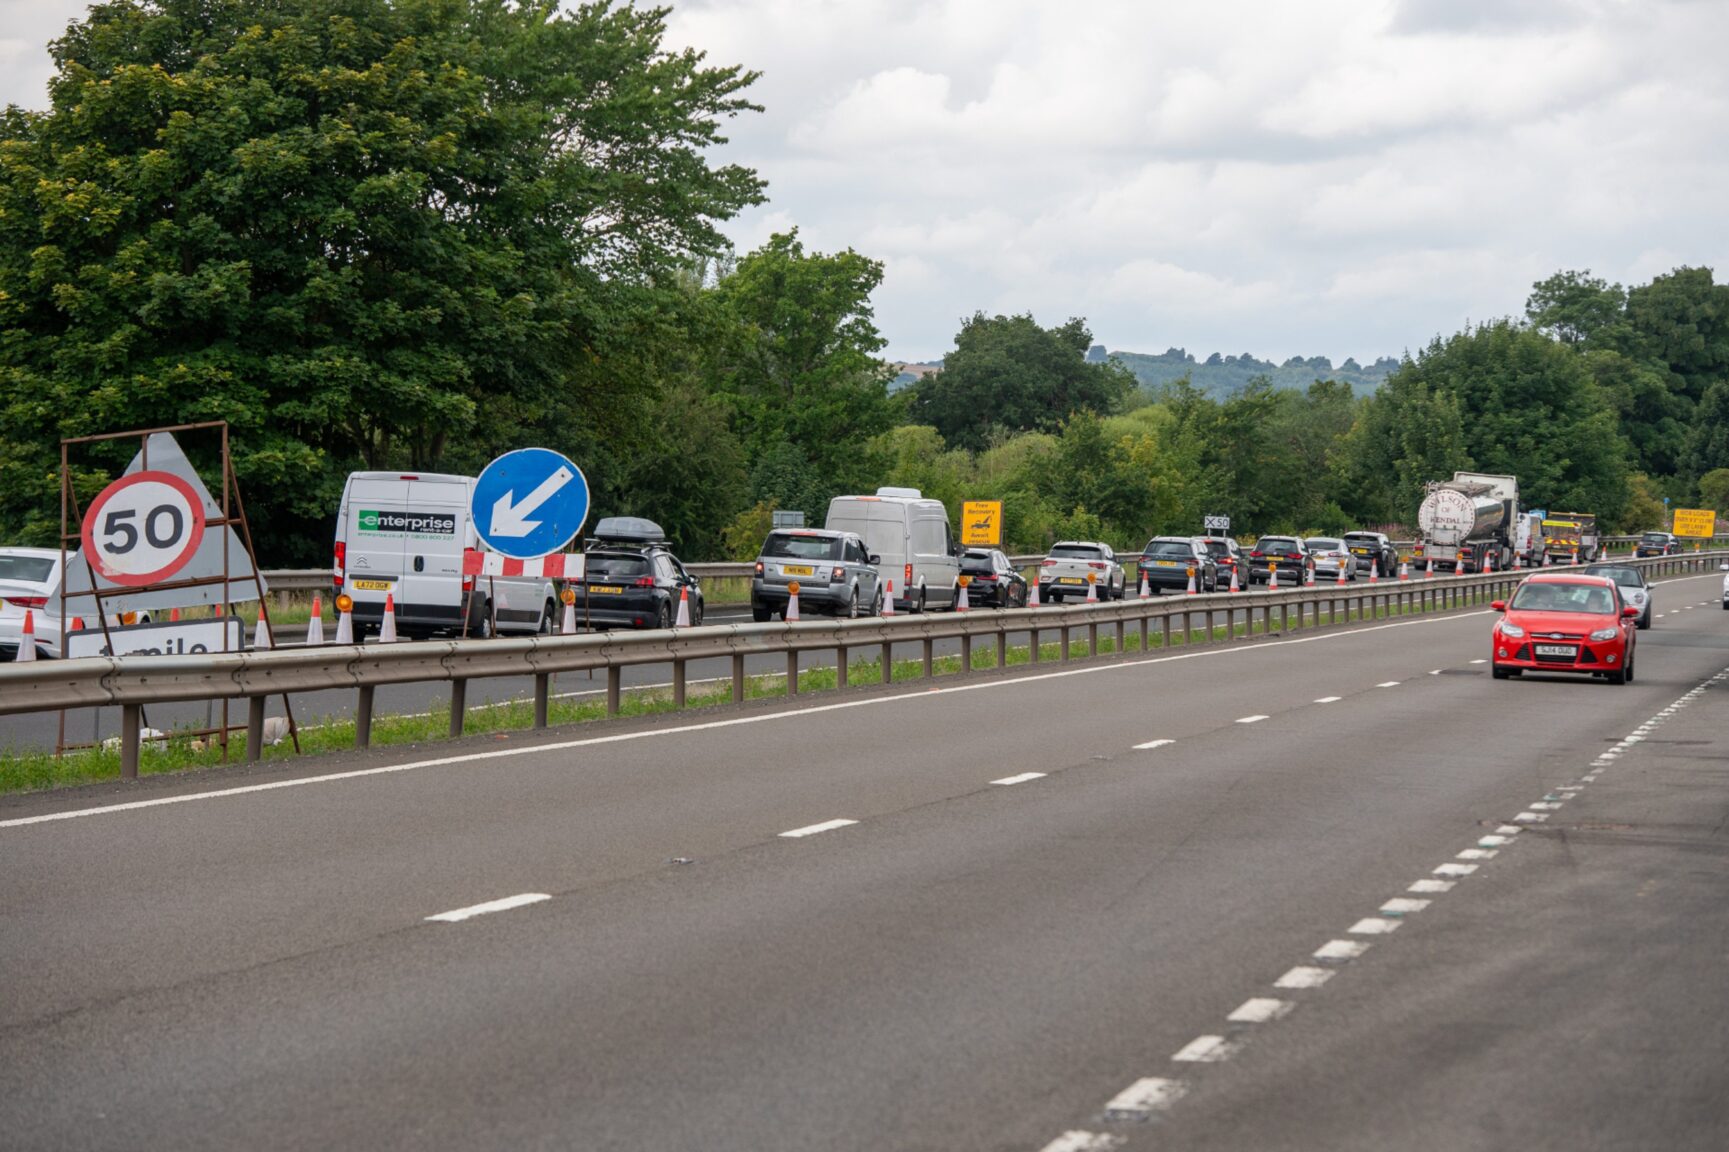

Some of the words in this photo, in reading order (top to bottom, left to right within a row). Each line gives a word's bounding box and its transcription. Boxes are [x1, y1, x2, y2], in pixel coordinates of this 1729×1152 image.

[1427, 495, 1468, 512] WILSON
[360, 515, 455, 530] enterprise
[1430, 516, 1461, 524] KENDAL
[103, 503, 184, 555] 50
